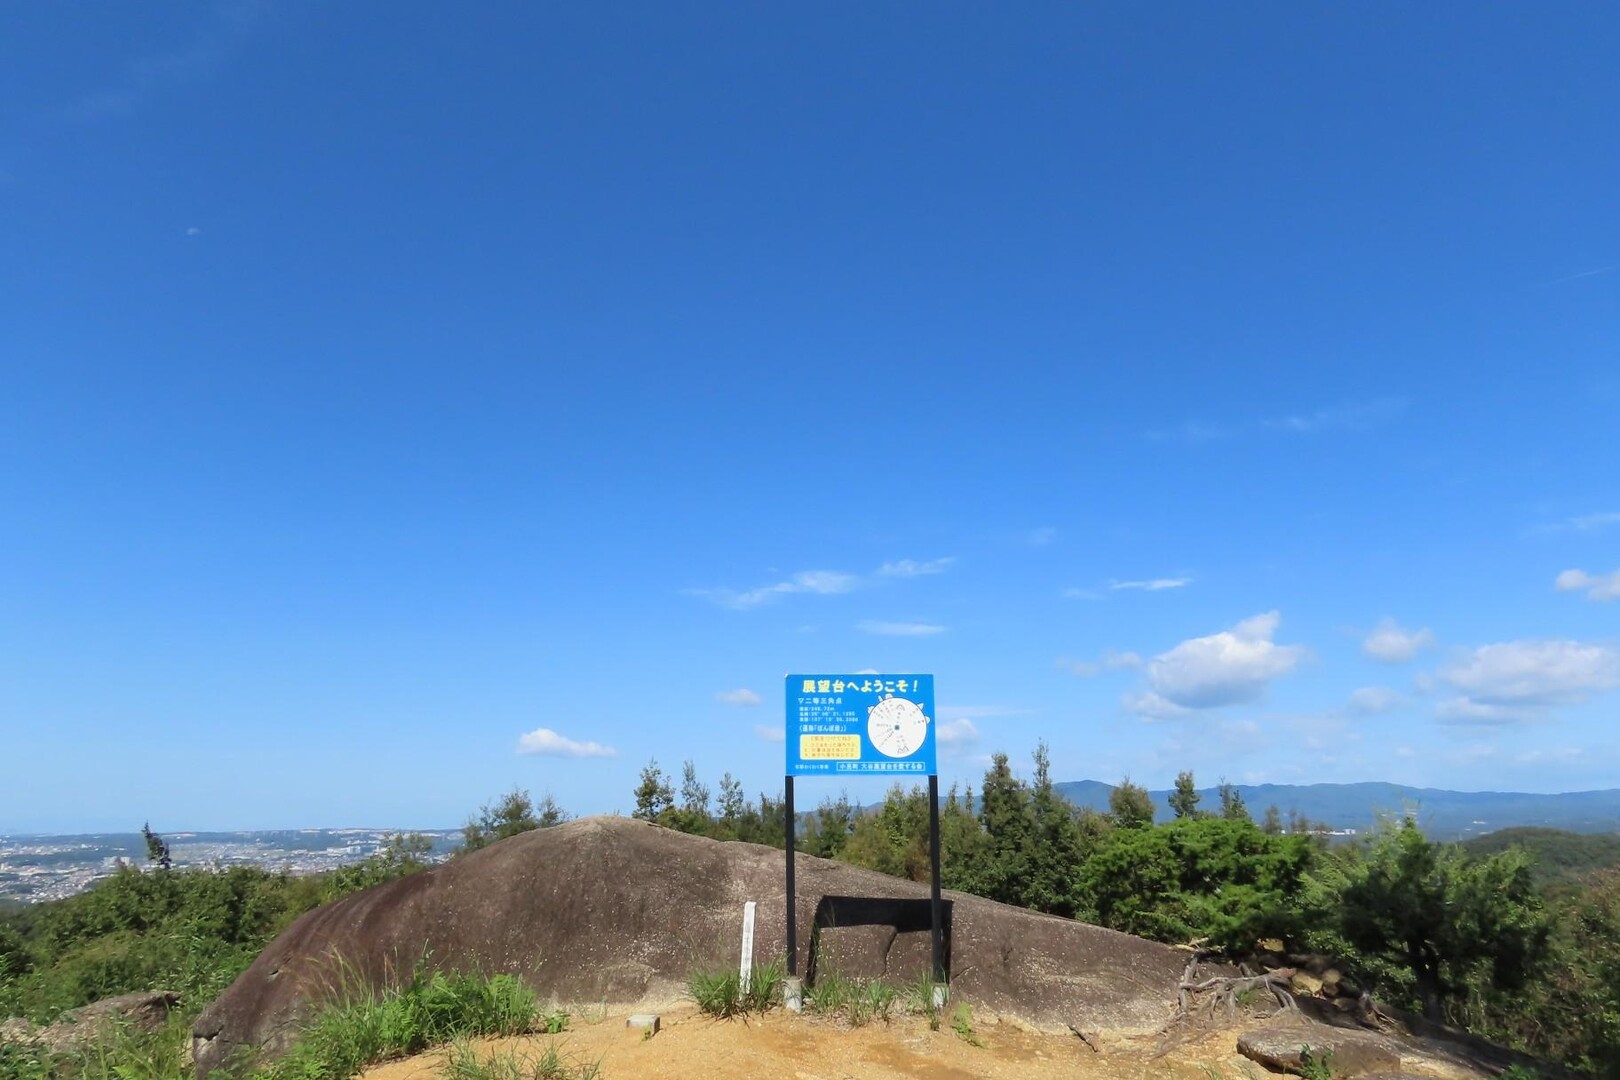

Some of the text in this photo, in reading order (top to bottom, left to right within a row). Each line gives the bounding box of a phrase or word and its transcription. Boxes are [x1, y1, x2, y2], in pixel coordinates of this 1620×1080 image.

[802, 679, 919, 693] 展望台へようこそ！
